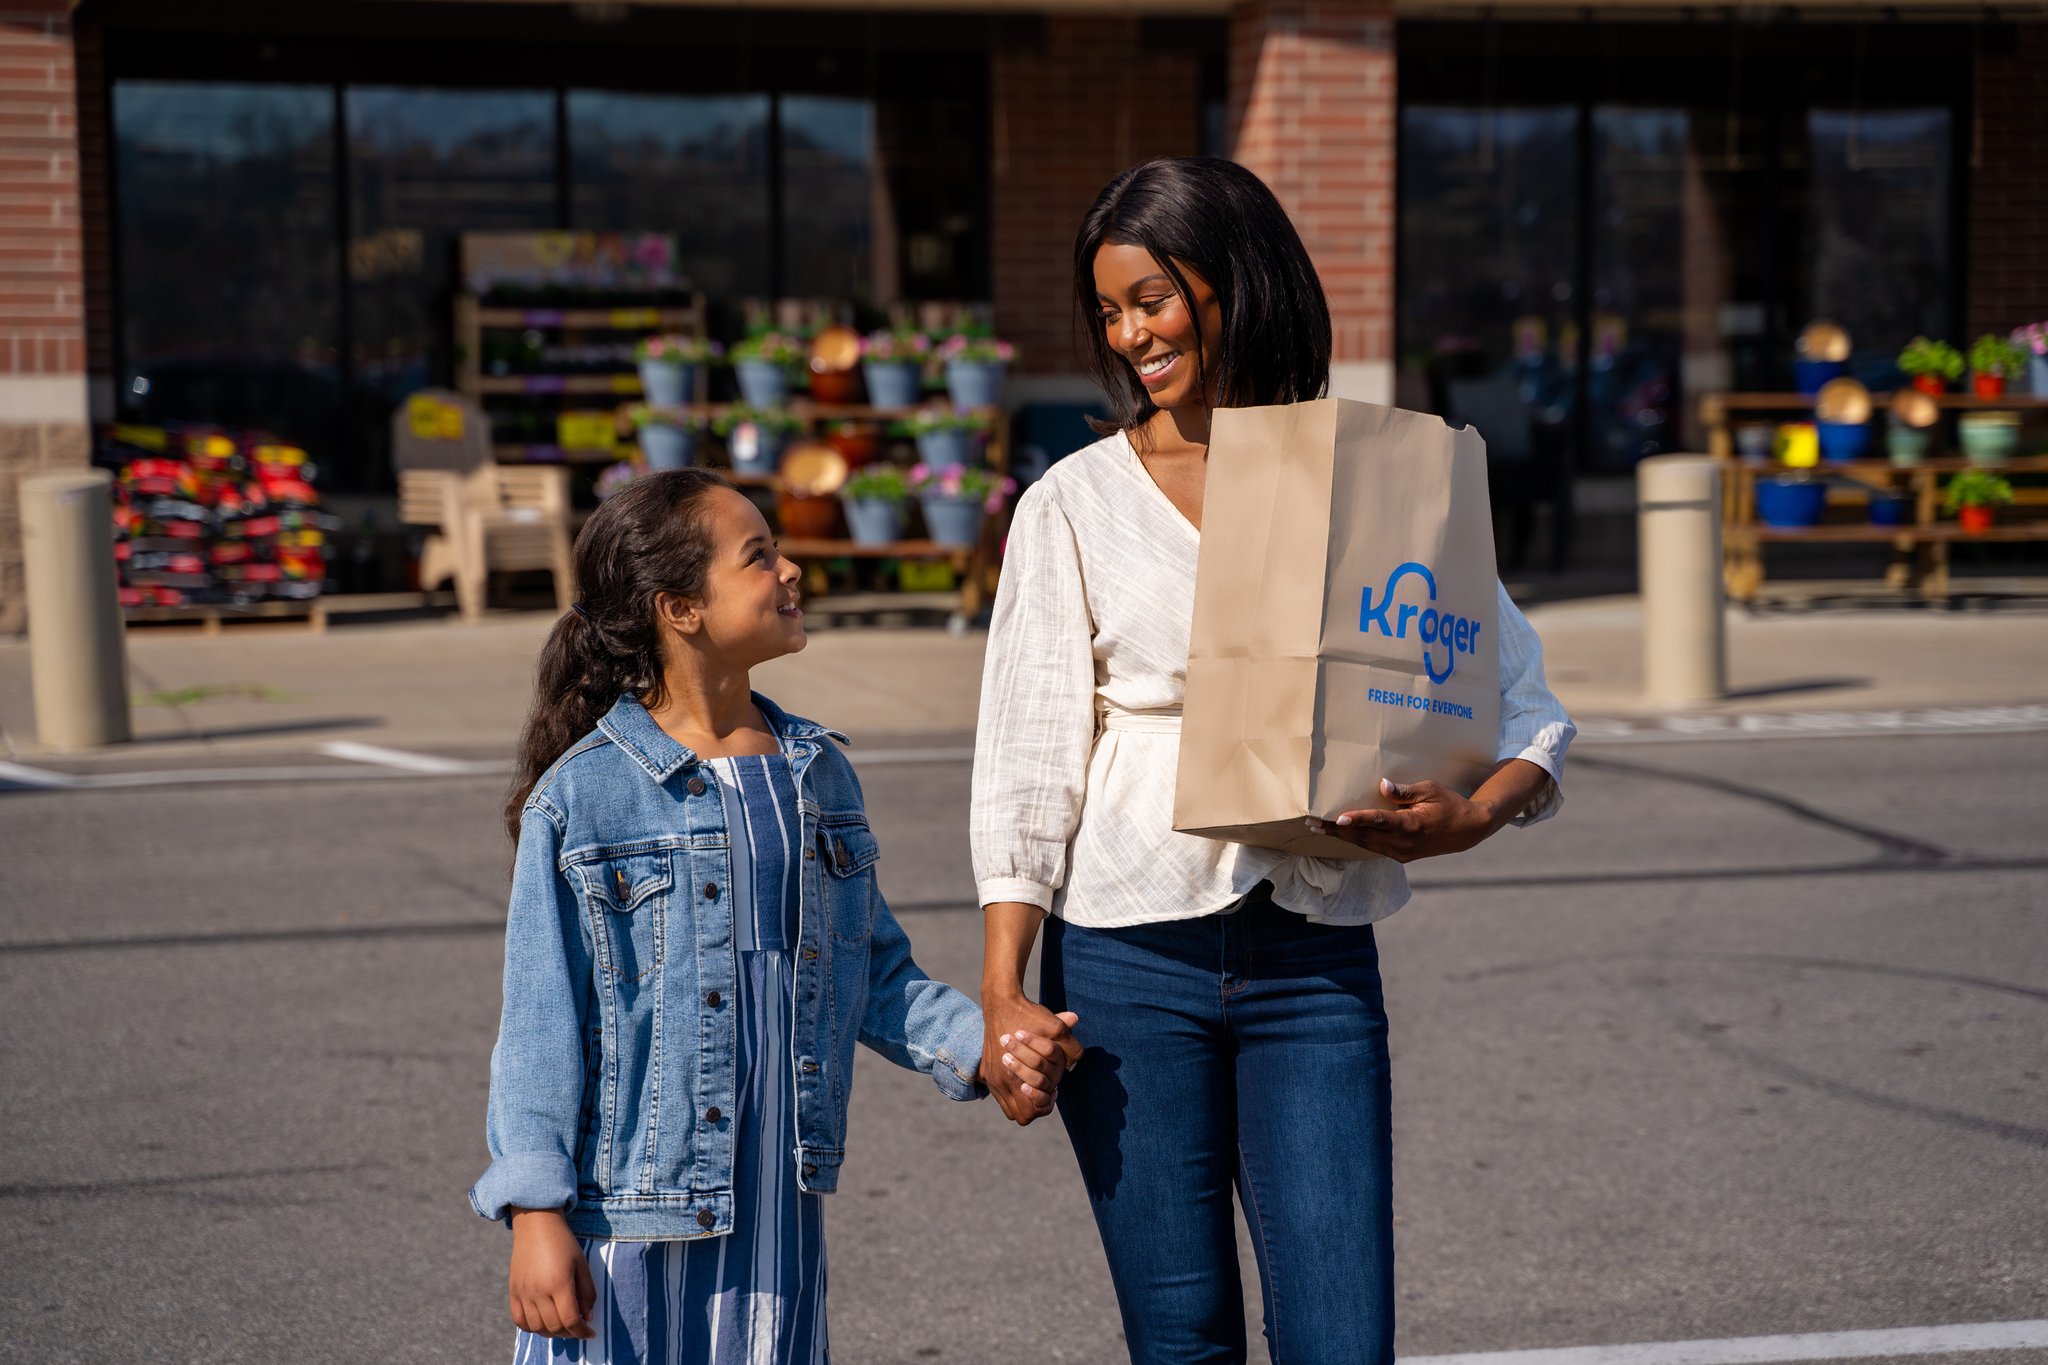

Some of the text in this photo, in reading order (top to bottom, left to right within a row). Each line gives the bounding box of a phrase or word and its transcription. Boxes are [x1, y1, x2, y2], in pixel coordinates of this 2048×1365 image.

[1359, 562, 1480, 685] Kroger
[1368, 688, 1403, 707] FRESH
[1407, 695, 1430, 711] FOR
